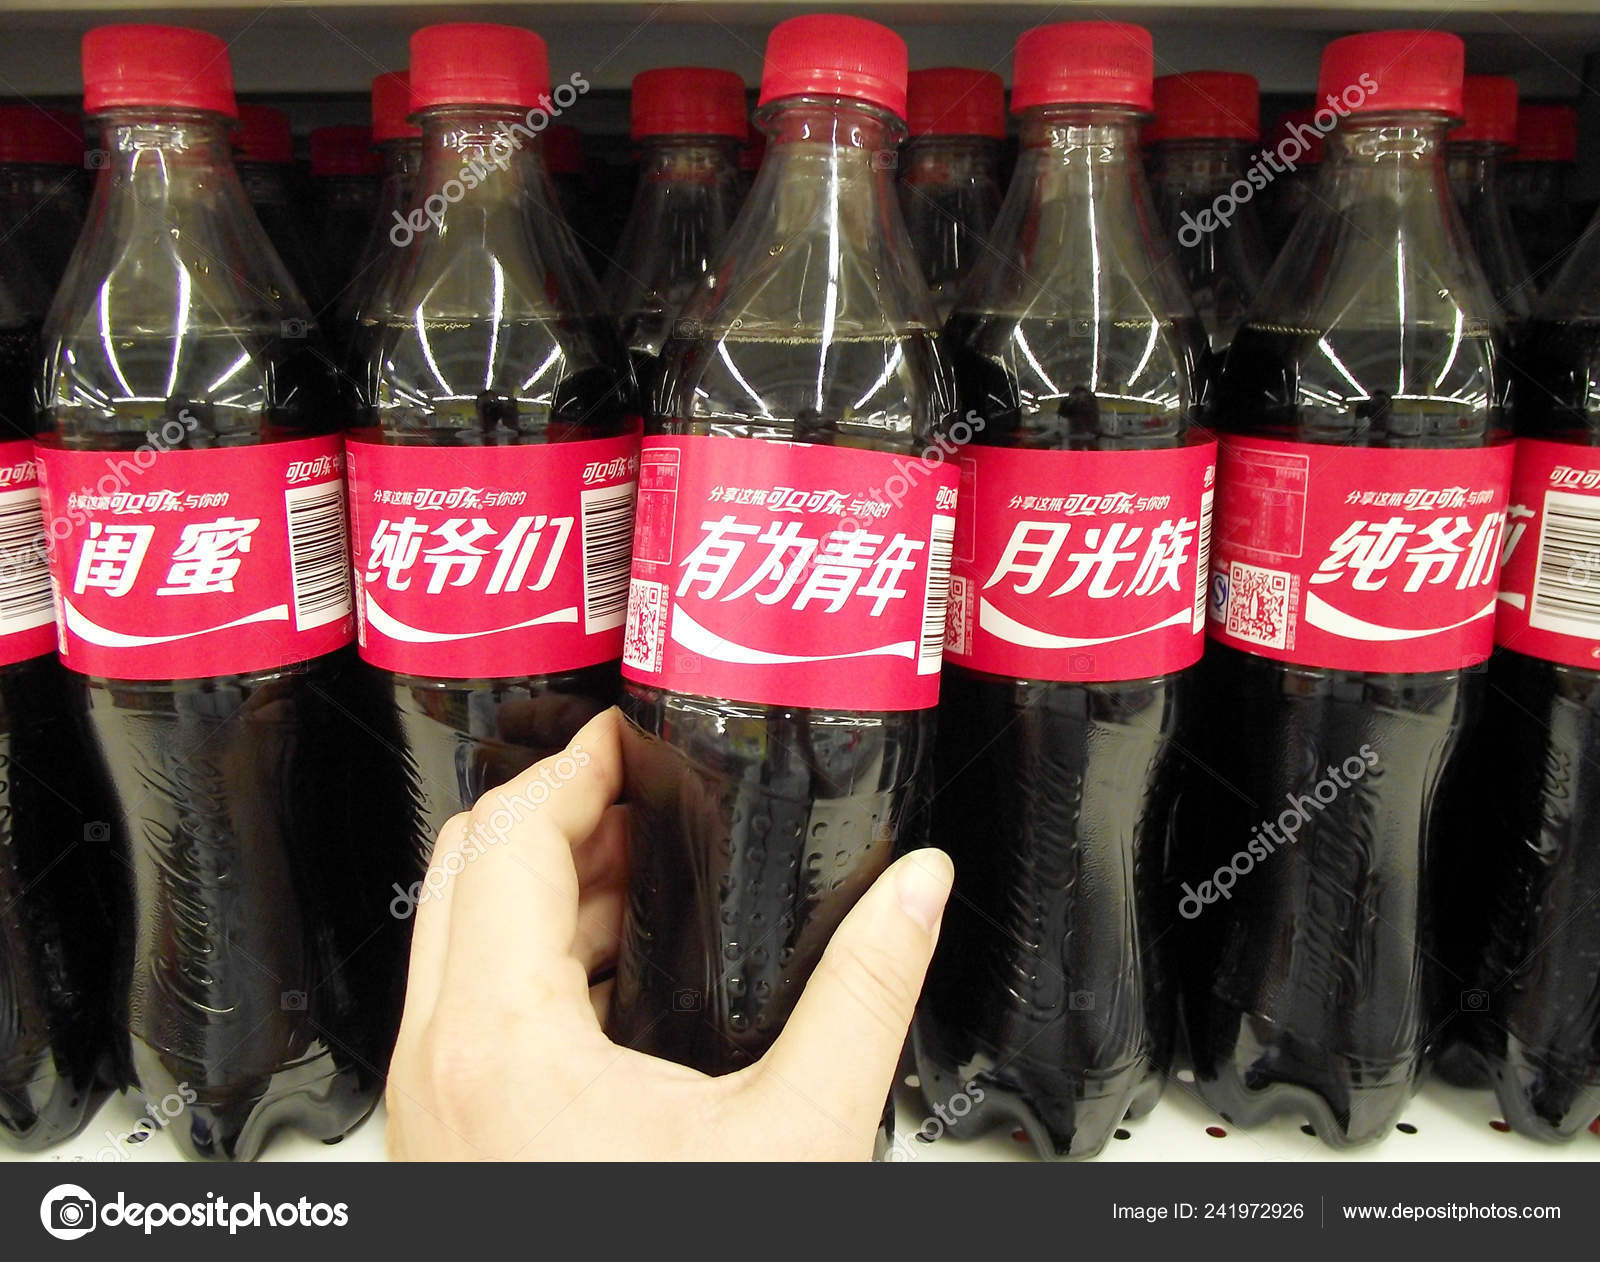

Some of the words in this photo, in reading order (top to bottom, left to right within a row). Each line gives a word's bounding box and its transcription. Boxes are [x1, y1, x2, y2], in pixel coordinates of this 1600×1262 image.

[73, 517, 260, 598] 闺蜜
[365, 515, 574, 595] 纯爷们
[674, 515, 925, 617] 有为青年
[982, 516, 1198, 599] 月光族
[1308, 512, 1506, 593] 纯爷们
